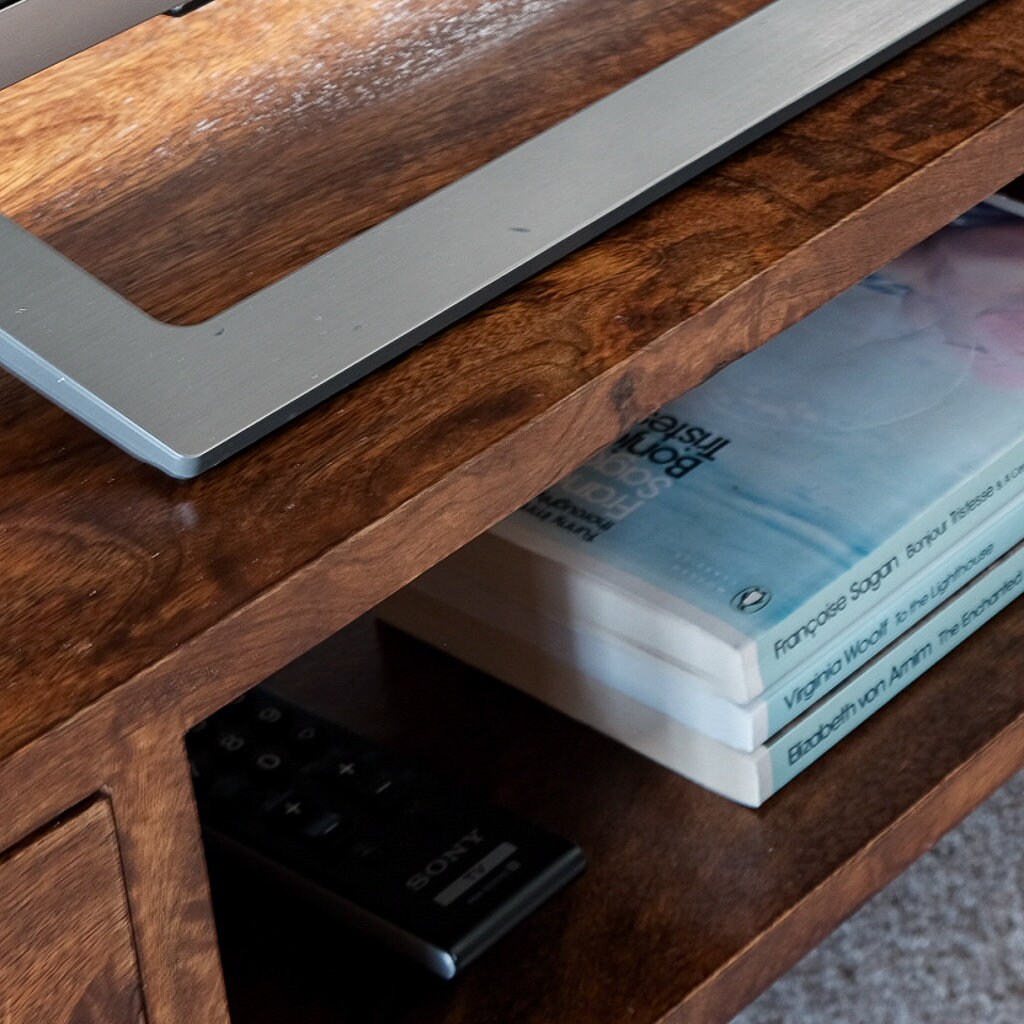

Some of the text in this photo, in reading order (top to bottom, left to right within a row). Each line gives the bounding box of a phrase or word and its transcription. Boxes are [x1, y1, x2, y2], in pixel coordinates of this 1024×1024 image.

[561, 478, 646, 523] Fran
[773, 594, 848, 660] Françoise
[849, 555, 900, 602] Sagan
[906, 519, 948, 561] Bonjour
[949, 484, 995, 527] Tristesse
[783, 543, 995, 710] Virginia Woolf To the Lighthouse
[787, 700, 858, 767] Elizabeth
[857, 678, 887, 710] von
[888, 642, 933, 688] Arnim
[937, 622, 961, 646] The
[961, 568, 1024, 628] Enchanted
[219, 733, 245, 752] 8
[406, 826, 484, 891] SONY
